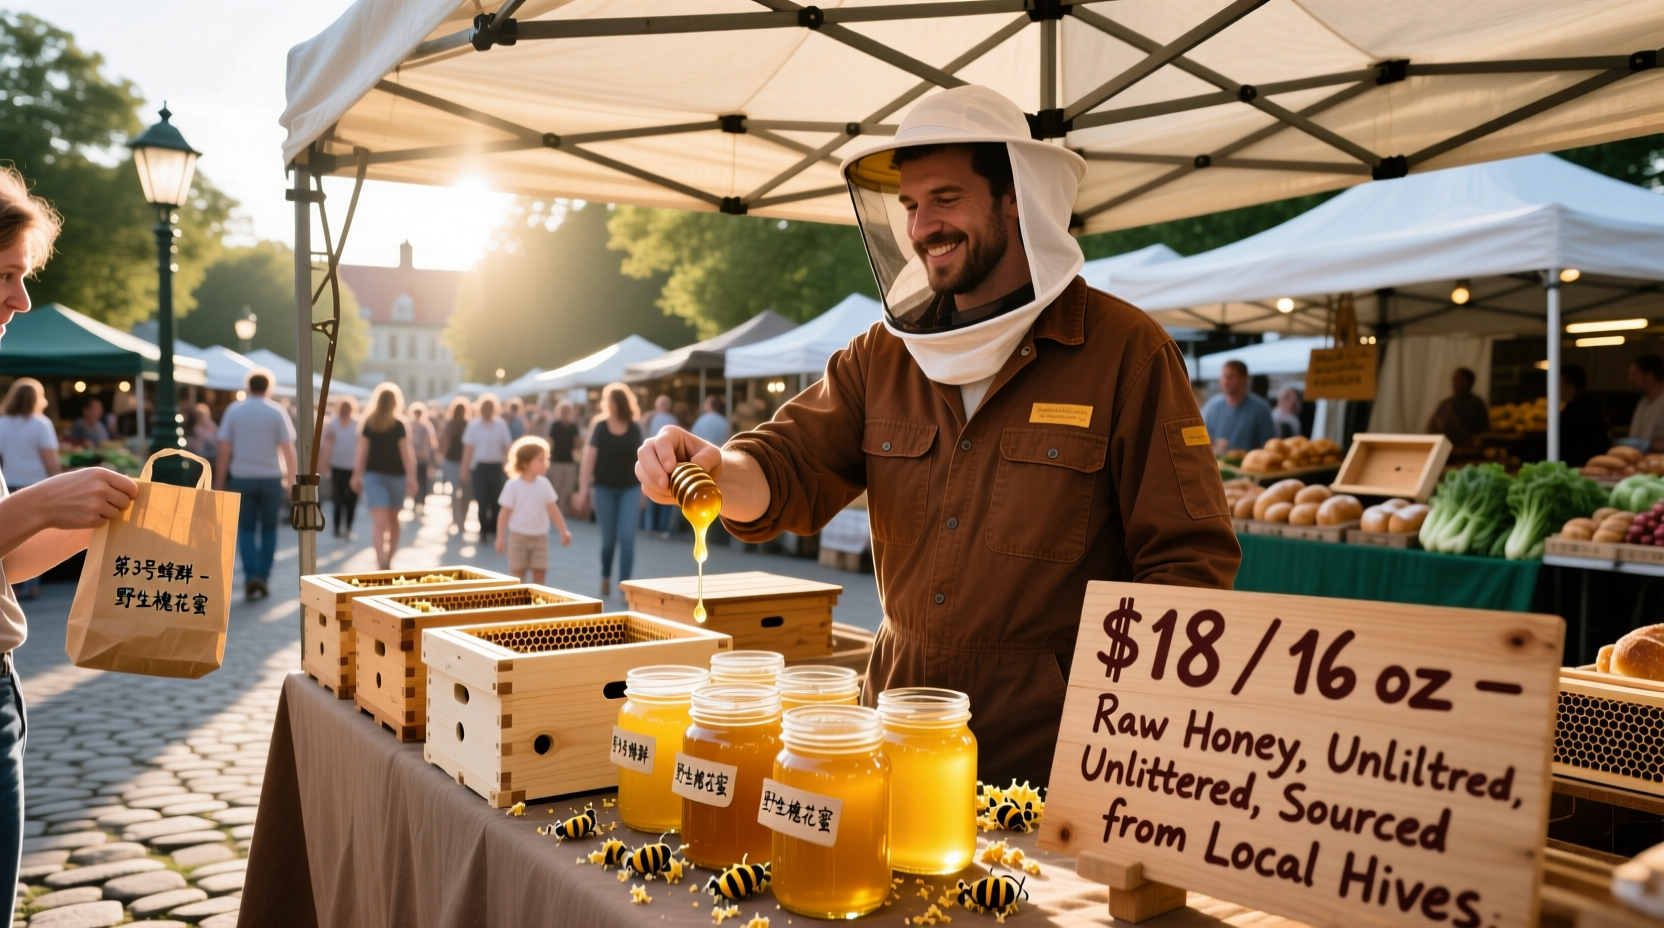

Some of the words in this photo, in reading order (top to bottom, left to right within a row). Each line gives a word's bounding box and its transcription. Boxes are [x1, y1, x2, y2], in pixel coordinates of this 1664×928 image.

[1096, 597, 1226, 688] $18
[1289, 629, 1357, 700] 16
[1375, 665, 1453, 712] oz
[1081, 744, 1261, 821] Unlittered,
[1278, 782, 1453, 854] Sourced
[1092, 692, 1169, 741] Raw
[1183, 709, 1308, 780] Honey,
[1327, 732, 1523, 811] Unliltred,
[1102, 797, 1187, 853] from
[1204, 820, 1321, 888] Local
